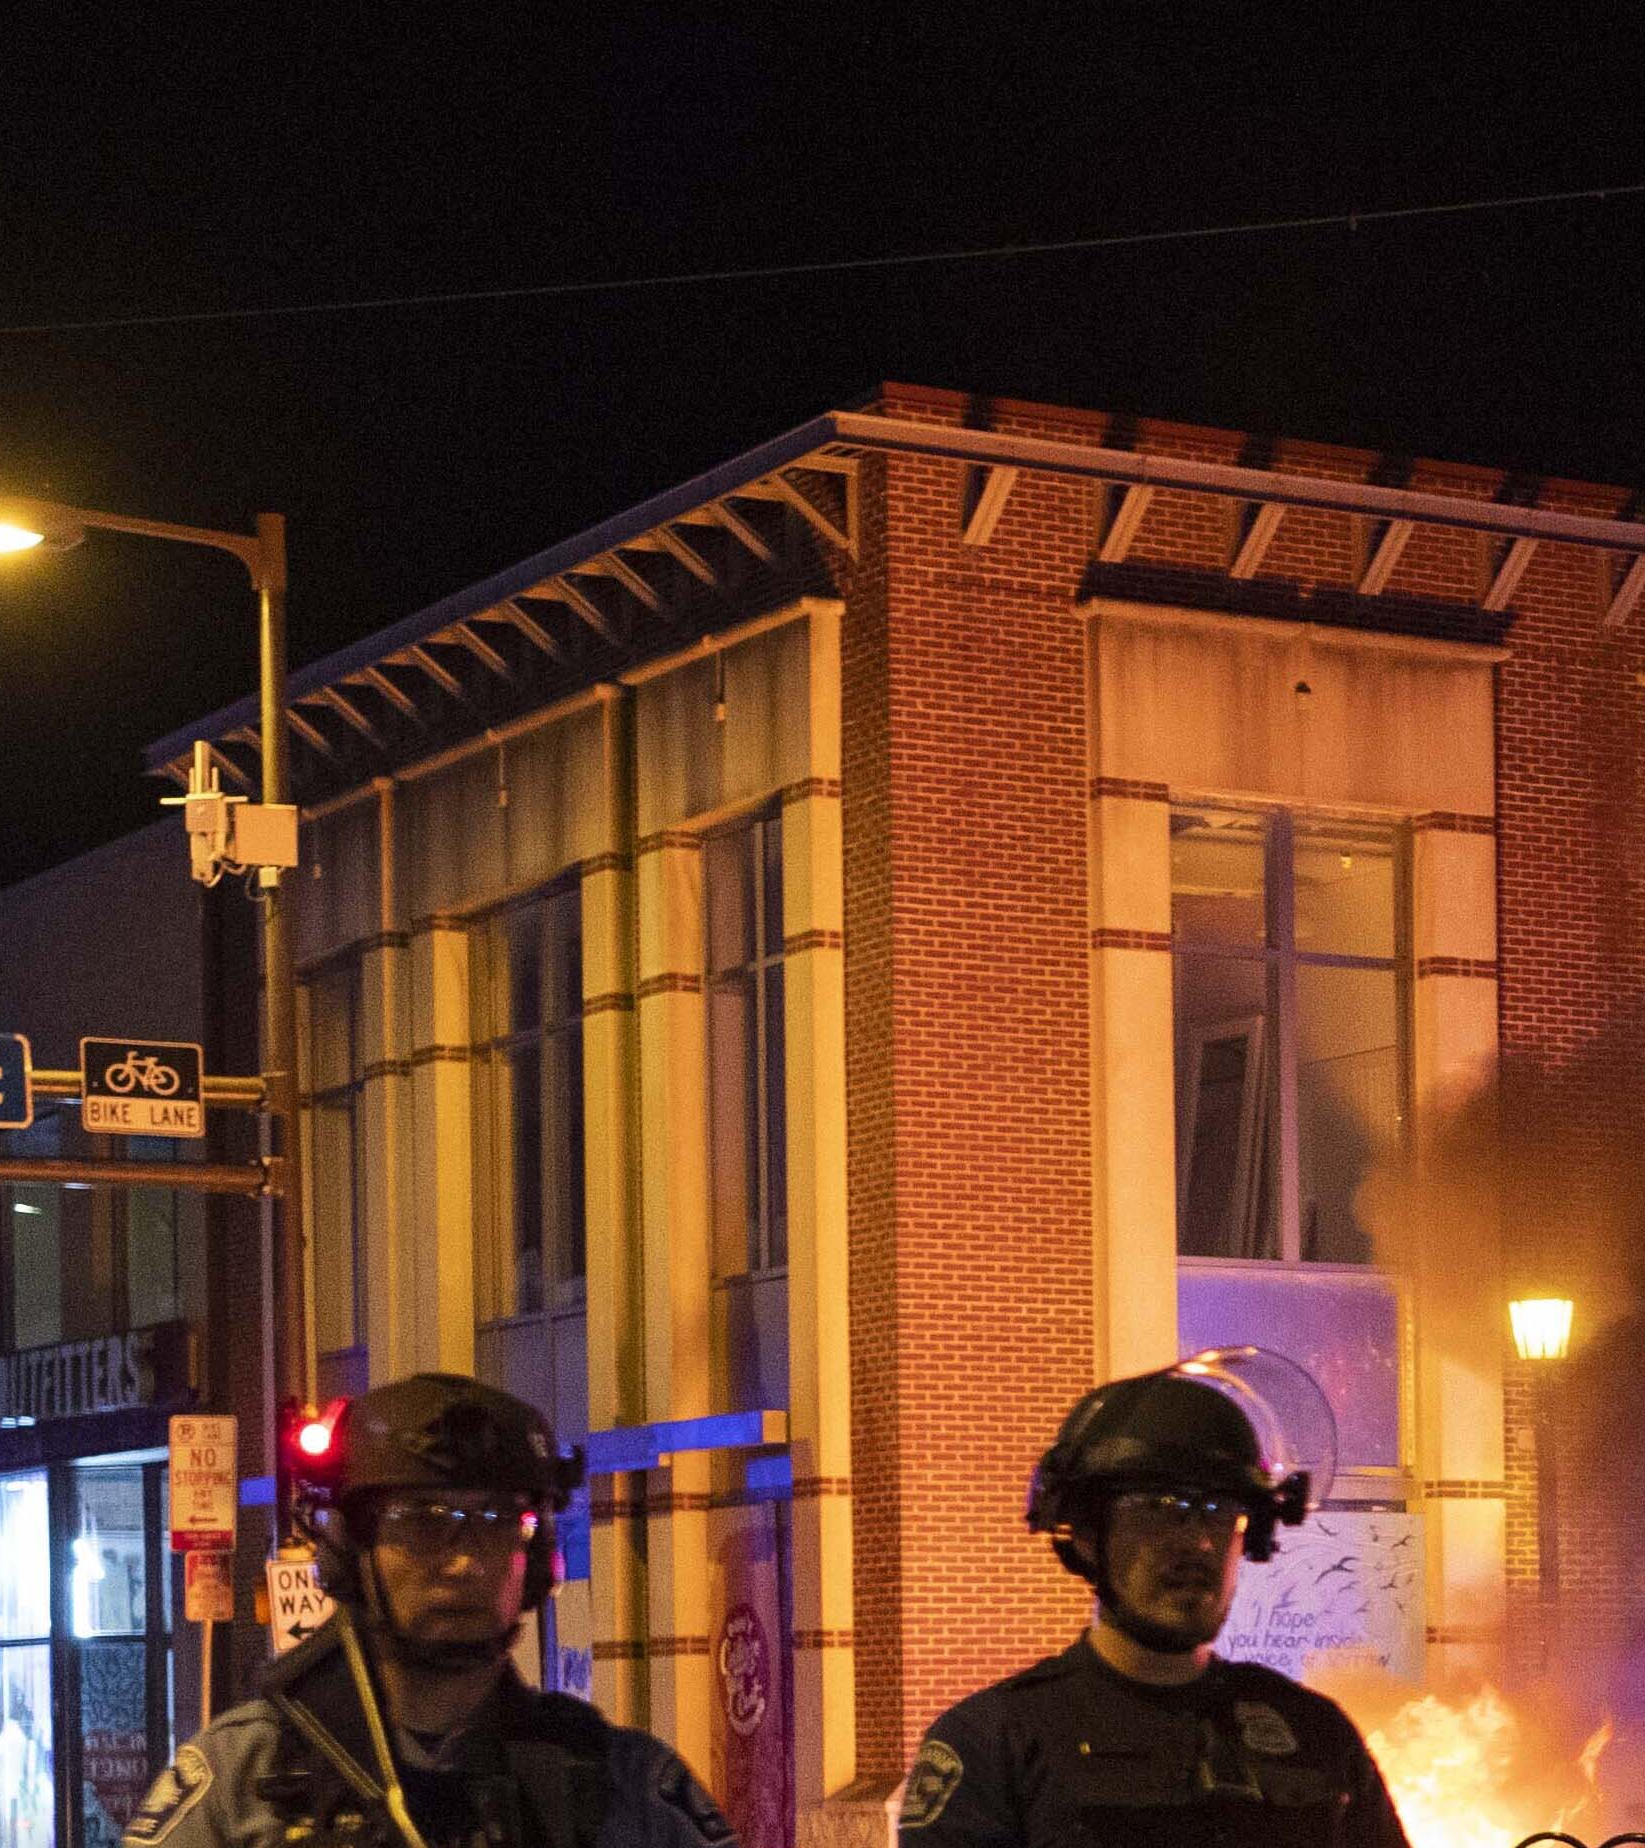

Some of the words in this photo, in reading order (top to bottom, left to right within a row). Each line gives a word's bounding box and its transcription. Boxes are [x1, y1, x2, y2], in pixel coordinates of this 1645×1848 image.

[89, 1101, 132, 1123] BIKE
[150, 1104, 197, 1128] LANE
[190, 1450, 216, 1467] NO
[278, 1570, 313, 1591] ON
[280, 1594, 327, 1615] WAY
[1268, 1607, 1316, 1635] hope
[1227, 1632, 1258, 1655] you
